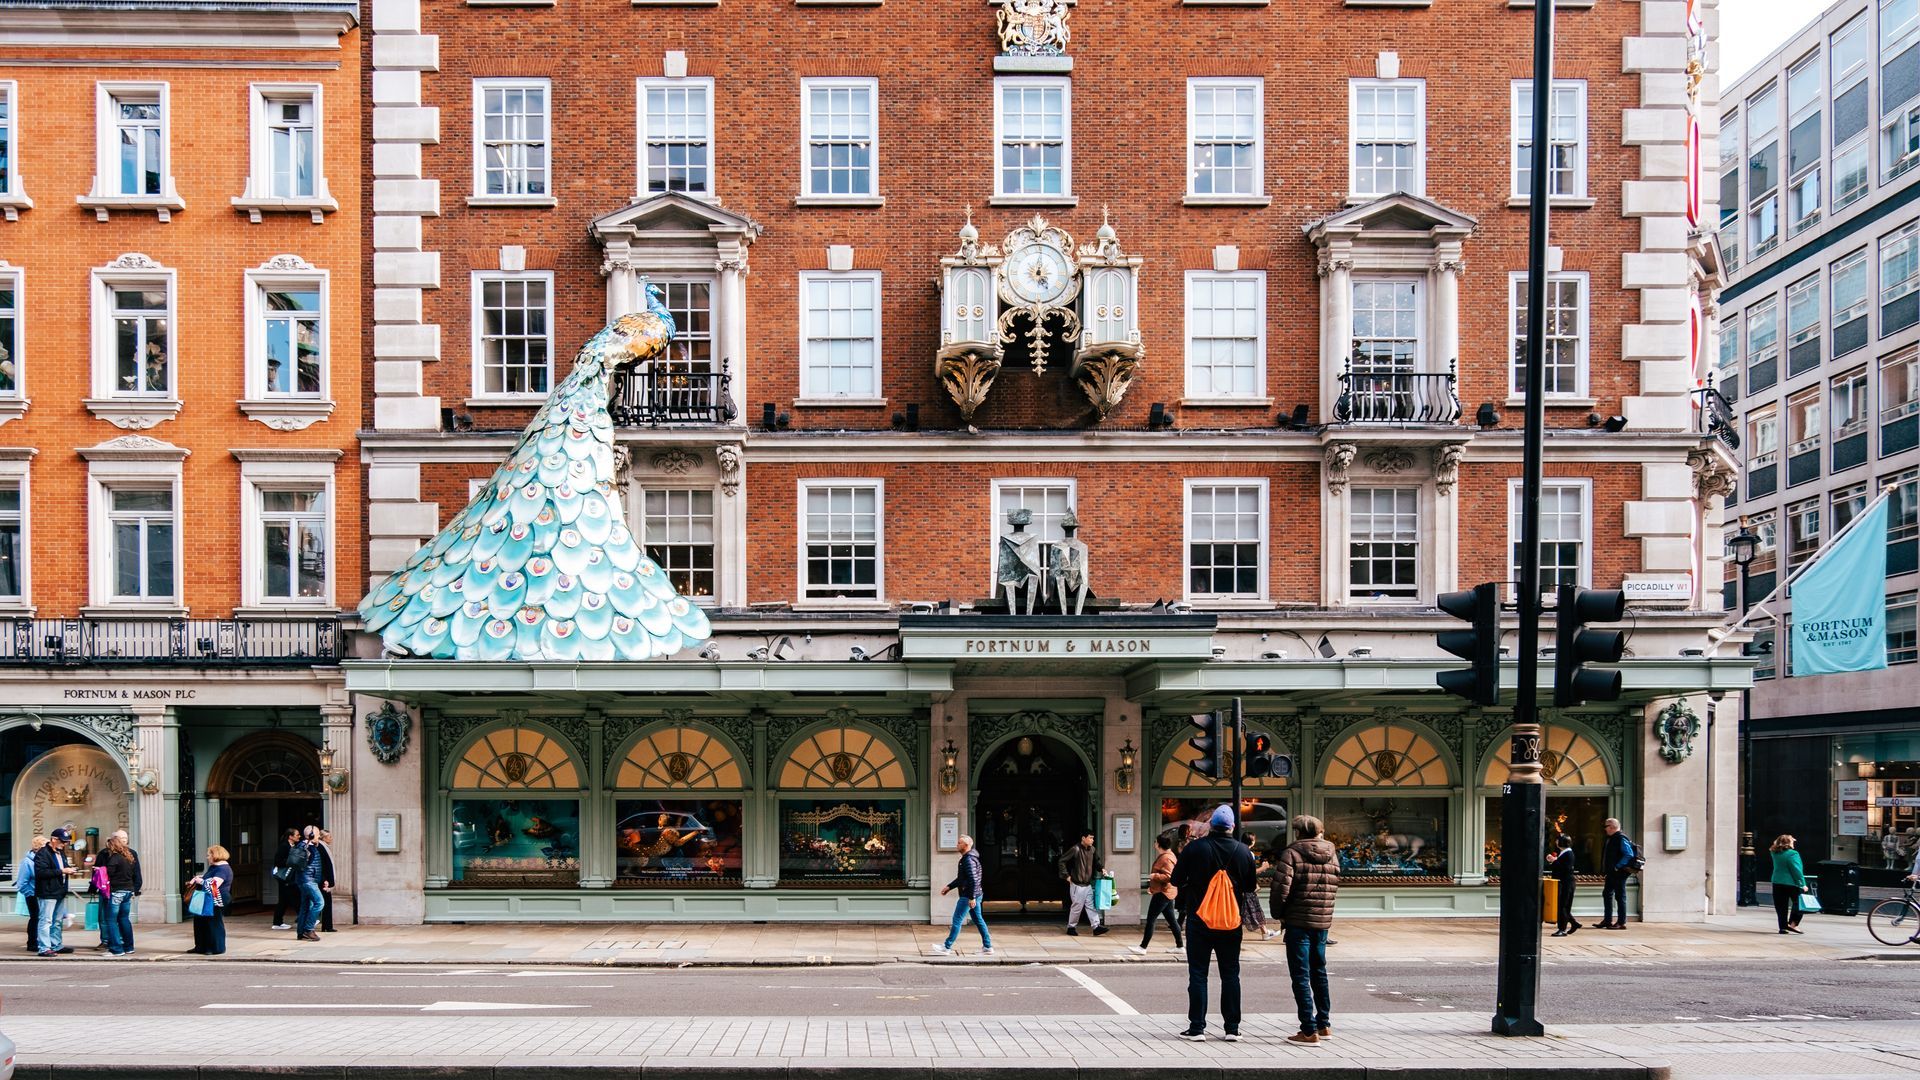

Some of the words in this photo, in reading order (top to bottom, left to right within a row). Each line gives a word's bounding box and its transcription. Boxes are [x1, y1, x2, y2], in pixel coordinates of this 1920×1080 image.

[1627, 583, 1674, 591] PICCADILLY
[1802, 617, 1873, 632] FORTNUM
[966, 640, 1050, 652] FORTNUM
[1065, 640, 1076, 652] &
[1090, 639, 1151, 652] MASON
[64, 689, 117, 698] FORTNUM
[121, 690, 129, 698] &
[133, 690, 171, 698] MASON
[175, 690, 196, 698] PLC
[59, 765, 75, 779] OF
[1503, 784, 1511, 794] 72
